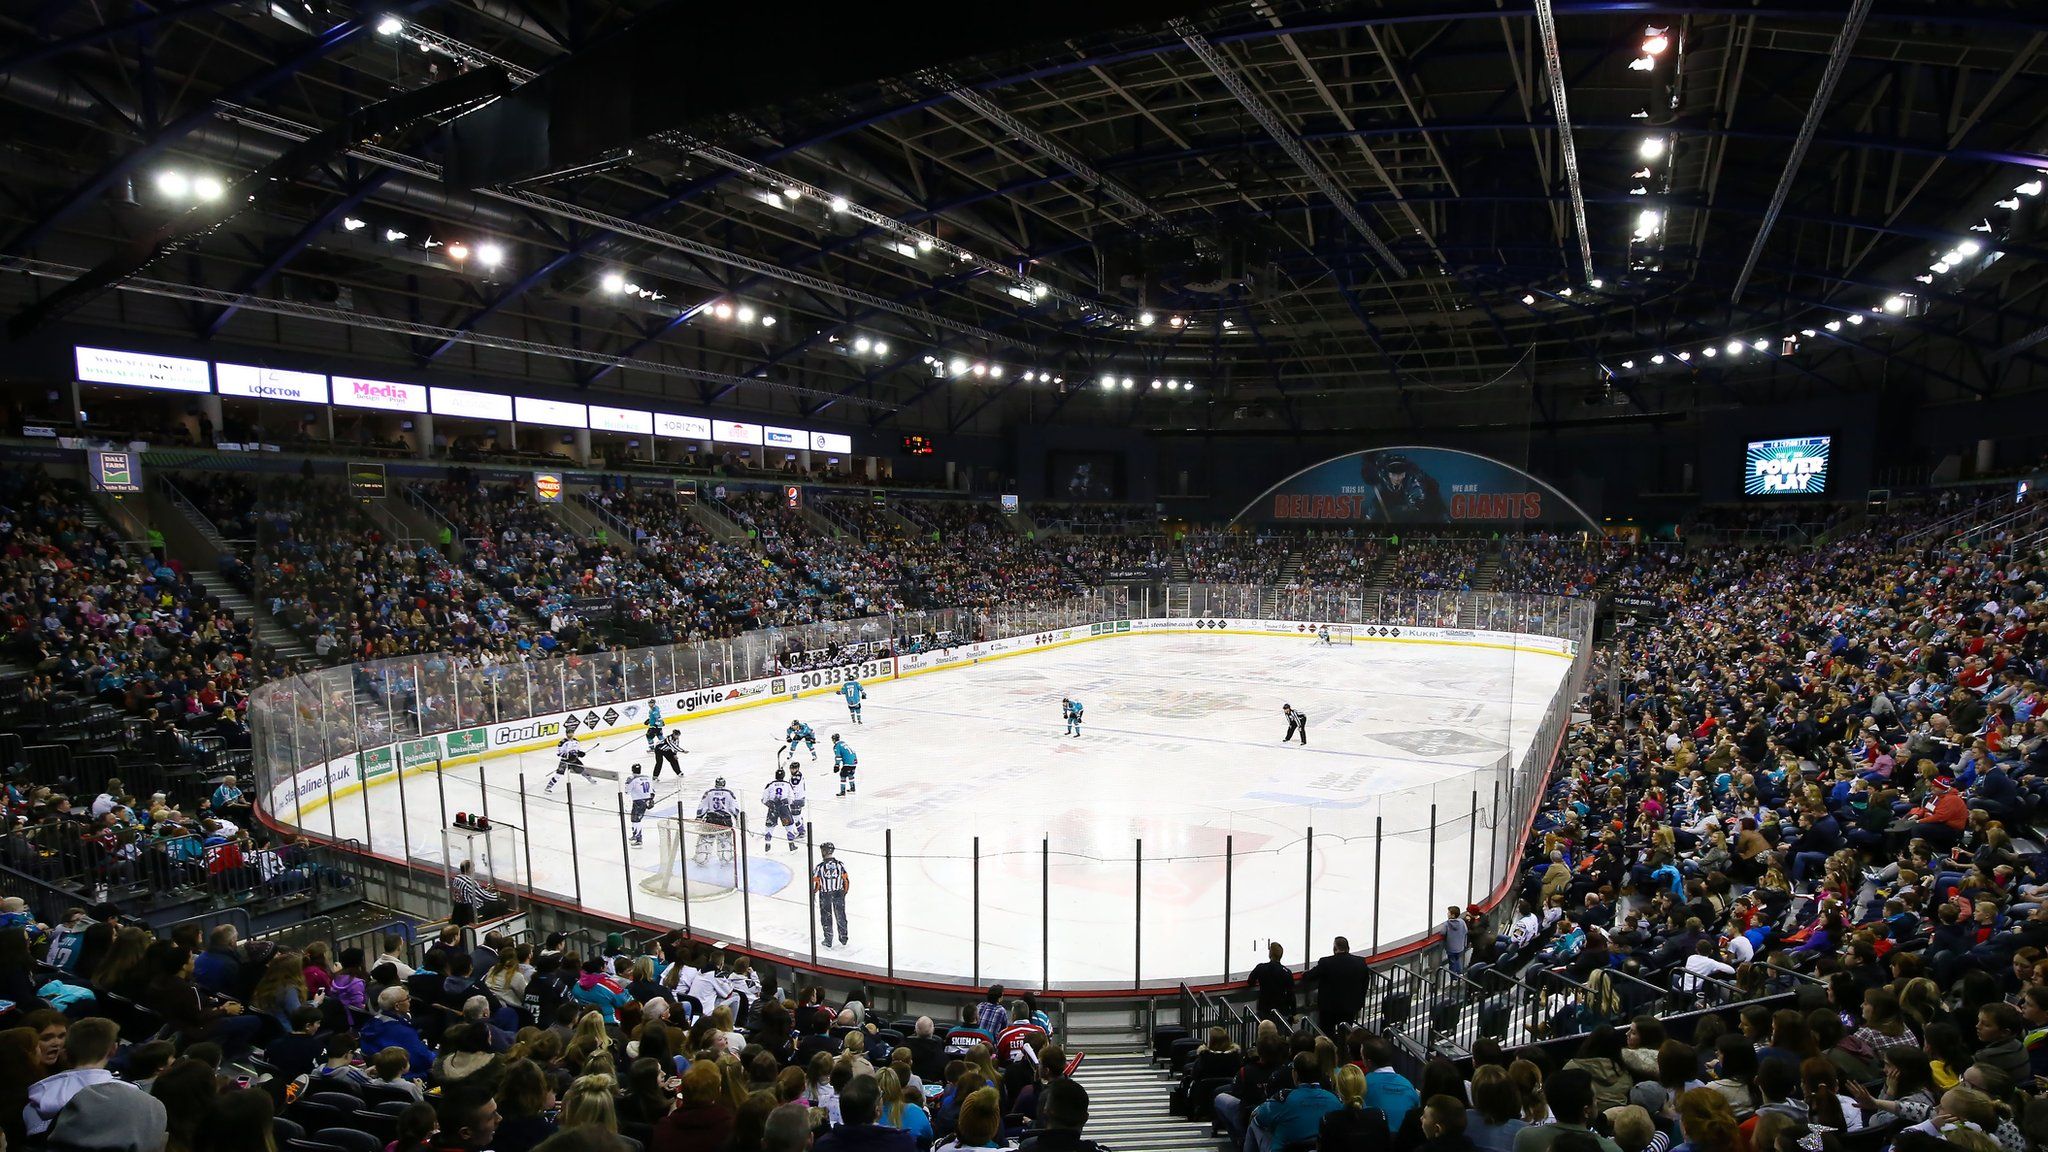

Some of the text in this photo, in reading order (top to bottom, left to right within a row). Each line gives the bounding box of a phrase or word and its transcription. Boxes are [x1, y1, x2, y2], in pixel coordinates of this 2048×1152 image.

[249, 385, 301, 398] LOCKTON
[353, 381, 408, 400] Media
[1755, 457, 1825, 476] POWER
[1452, 484, 1478, 492] WE ARE
[1763, 473, 1812, 491] PLAY
[1342, 486, 1357, 494] THIS
[1274, 494, 1365, 519] BELFAST
[1451, 492, 1541, 519] GIANTS
[1408, 629, 1439, 638] KUKRI
[789, 663, 877, 692] 028 90 33 33 33
[847, 687, 855, 697] 17
[676, 689, 724, 712] ogilvie
[450, 742, 486, 755] Heineken
[404, 750, 436, 764] Heineken
[362, 760, 391, 773] eineken
[775, 787, 783, 797] 8
[712, 797, 726, 811] 31
[825, 869, 839, 879] 44
